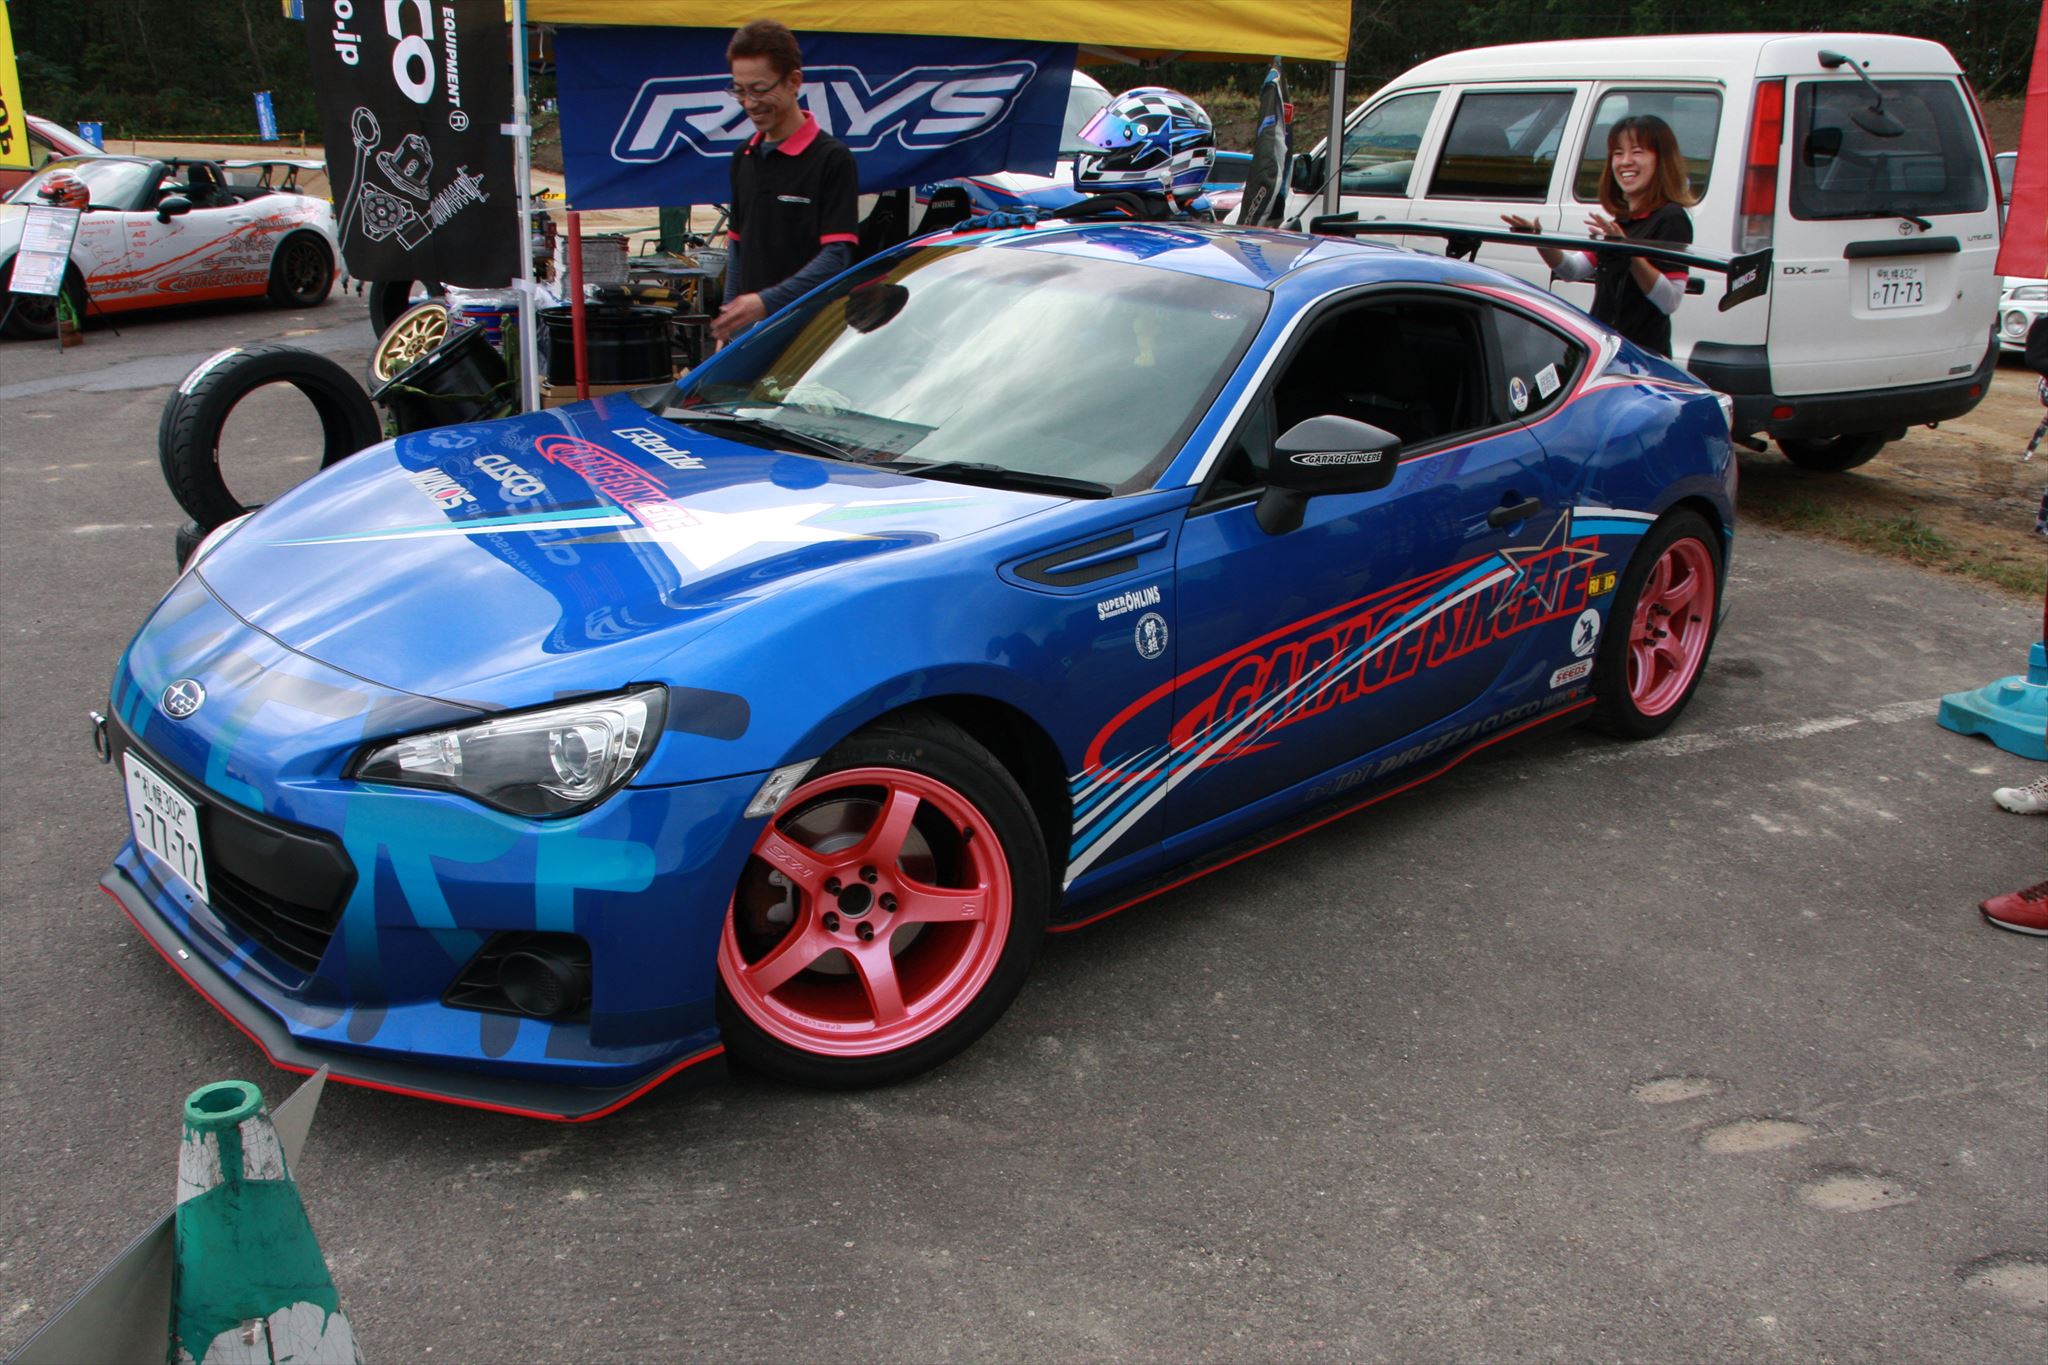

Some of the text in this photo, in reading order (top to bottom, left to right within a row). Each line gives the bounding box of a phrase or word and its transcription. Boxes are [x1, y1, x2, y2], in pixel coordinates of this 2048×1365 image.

[442, 6, 460, 107] EQUIPMENT
[626, 72, 1026, 153] RAYS
[1783, 266, 1807, 275] DX
[1882, 281, 1923, 305] 77-73
[1305, 451, 1382, 465] GARAGE SINCERE
[1555, 664, 1588, 683] SEEDS
[144, 803, 204, 893] 77-72
